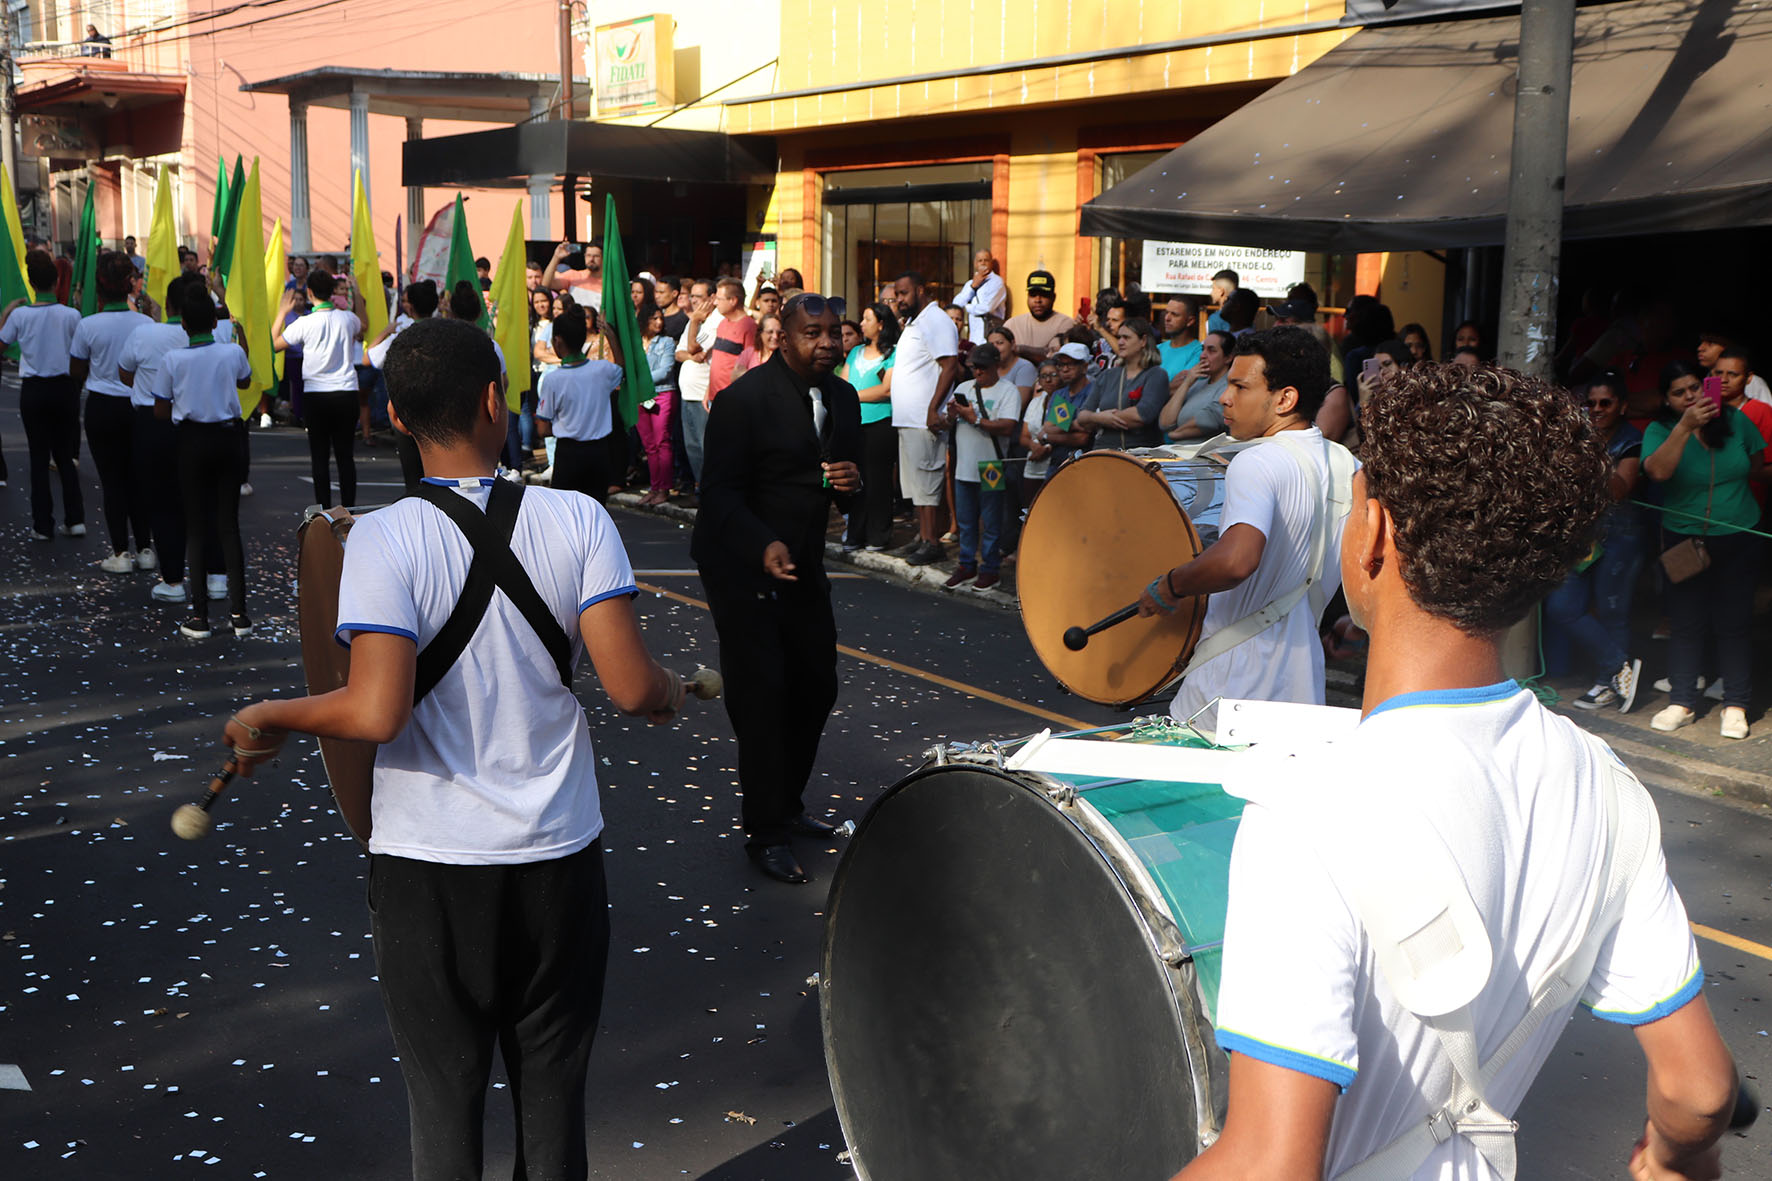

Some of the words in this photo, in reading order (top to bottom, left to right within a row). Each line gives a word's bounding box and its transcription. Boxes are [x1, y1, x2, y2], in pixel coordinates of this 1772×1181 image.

[609, 62, 646, 83] FIDATI
[1156, 247, 1203, 257] ESTAREMOS
[1204, 248, 1216, 257] EM
[1218, 248, 1242, 257] NOVO
[1244, 249, 1292, 260] ENDEREÇO
[1168, 259, 1189, 268] PARA
[1191, 260, 1225, 270] MELHOR
[1165, 271, 1177, 280] Rua
